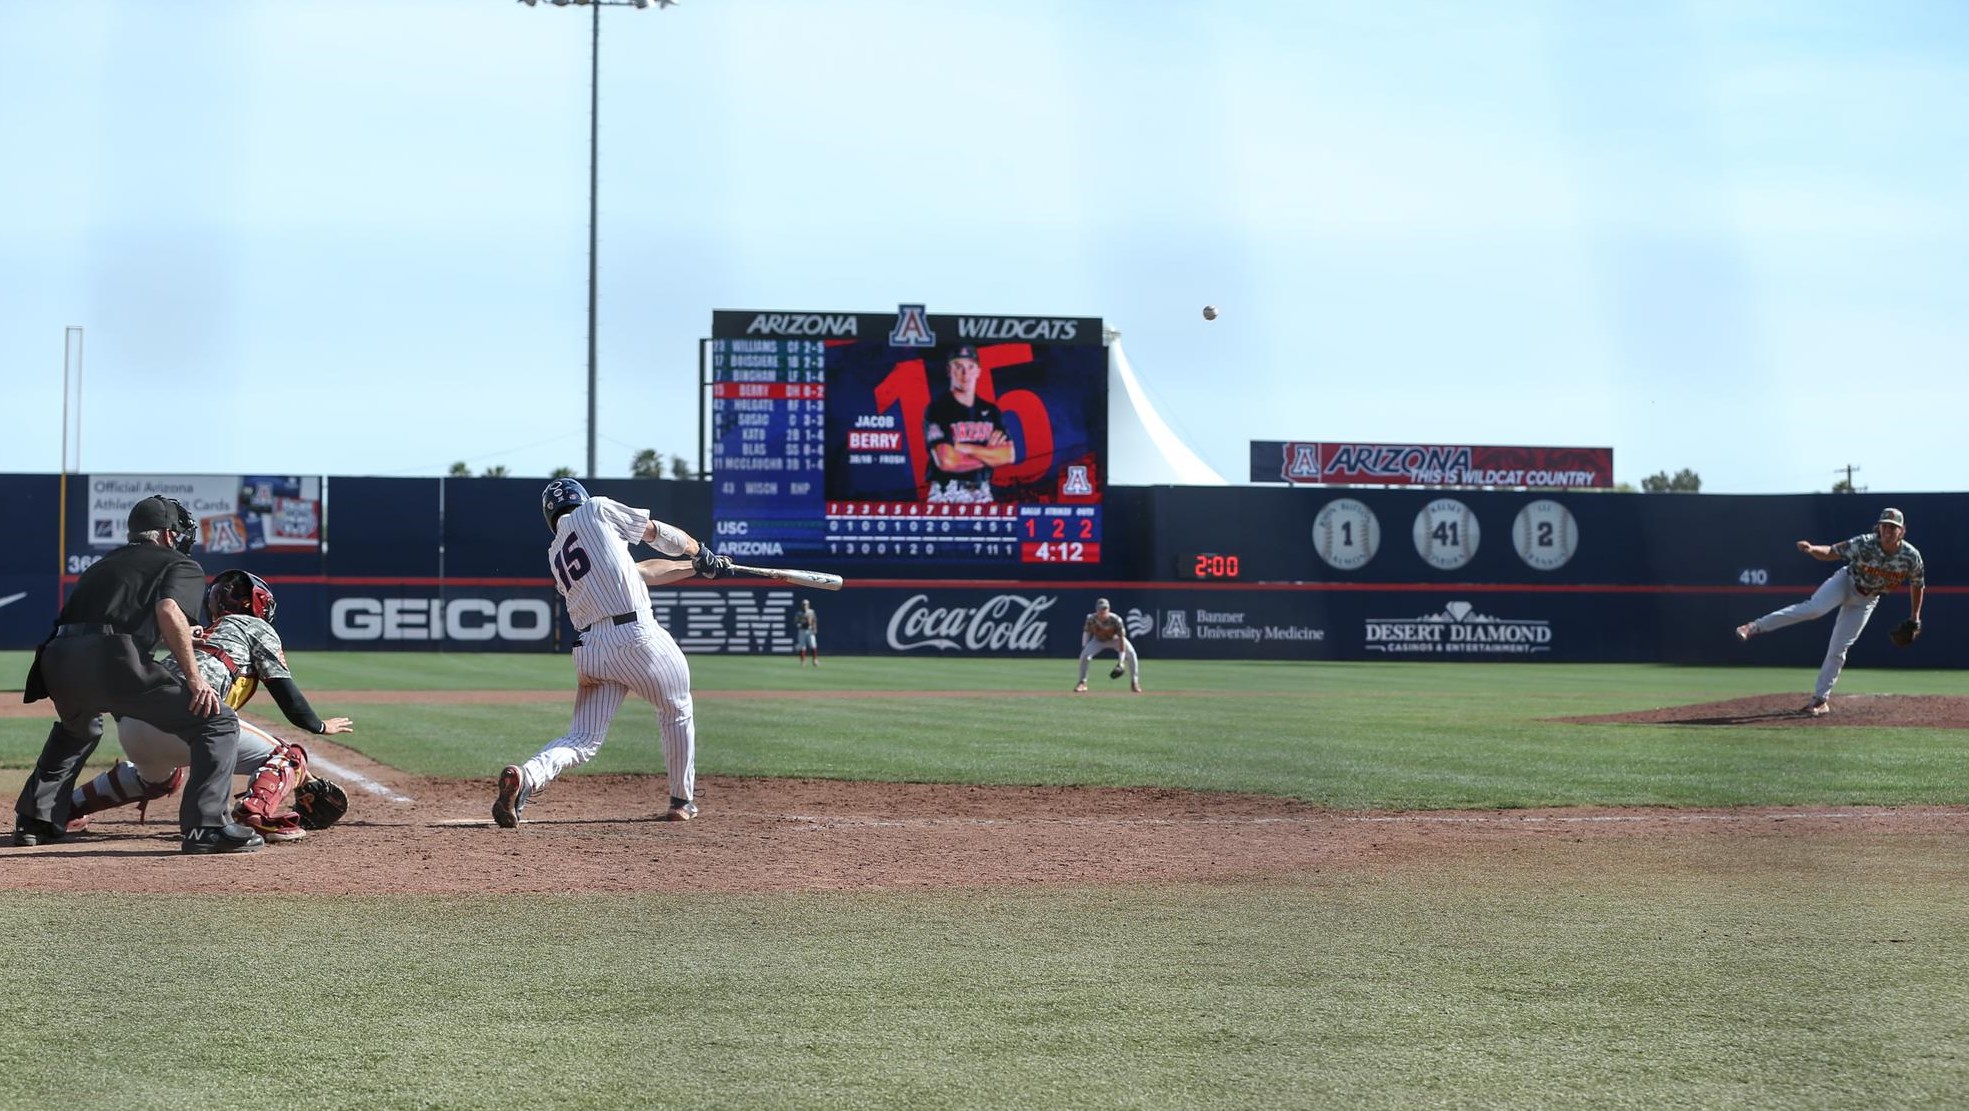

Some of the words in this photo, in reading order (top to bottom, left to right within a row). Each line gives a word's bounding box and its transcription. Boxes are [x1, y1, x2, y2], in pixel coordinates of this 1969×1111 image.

[746, 314, 858, 336] ARIZONA
[889, 304, 935, 346] A
[957, 318, 1078, 340] WILDCATS
[732, 340, 777, 353] WILLIAMS
[733, 370, 776, 382] BINGHAM
[739, 384, 769, 397] BERRY
[854, 415, 895, 428] JACOB
[742, 428, 766, 440] KATO
[850, 432, 900, 448] BERRY
[742, 443, 767, 455] BLAS
[1324, 445, 1472, 475] ARIZONA
[1410, 468, 1441, 483] THIS
[1444, 469, 1458, 484] IS
[1461, 469, 1524, 485] WILDCAT
[1526, 471, 1595, 486] COUNTRY
[94, 480, 140, 494] Official
[143, 481, 194, 494] Arizona
[193, 499, 231, 511] Cards
[717, 521, 748, 535] USC
[830, 521, 838, 532] 0
[847, 521, 853, 532] 1
[861, 521, 870, 532] 0
[877, 521, 886, 532] 0
[895, 521, 900, 532] 1
[909, 521, 918, 532] 0
[926, 521, 934, 532] 2
[941, 521, 950, 532] 0
[973, 521, 982, 532] 4
[1006, 521, 1012, 532] 1
[1026, 518, 1035, 538] 1
[1052, 519, 1065, 538] 2
[1080, 519, 1092, 538] 2
[1342, 520, 1354, 546] 1
[1432, 520, 1459, 546] 41
[1537, 521, 1553, 547] 2
[717, 541, 784, 556] ARIZONA
[831, 543, 837, 554] 1
[847, 543, 855, 554] 3
[861, 543, 870, 554] 0
[877, 543, 886, 554] 0
[895, 543, 900, 554] 1
[910, 543, 918, 554] 2
[926, 543, 934, 554] 0
[973, 543, 982, 554] 7
[987, 543, 998, 554] 11
[1006, 543, 1012, 554] 1
[1036, 542, 1083, 562] 4:12
[554, 531, 591, 592] 15
[1195, 556, 1239, 577] 2:00
[1739, 569, 1768, 585] 410
[330, 598, 550, 640] GEICO
[886, 594, 1058, 650] Coca-Cola
[1196, 609, 1245, 623] Banner
[1196, 626, 1261, 643] University
[1264, 626, 1324, 641] Medicine
[1365, 624, 1444, 641] DESERT
[1450, 625, 1552, 642] DIAMOND
[1387, 643, 1433, 652] CASINOS
[1445, 643, 1530, 653] ENTERTAINMENT
